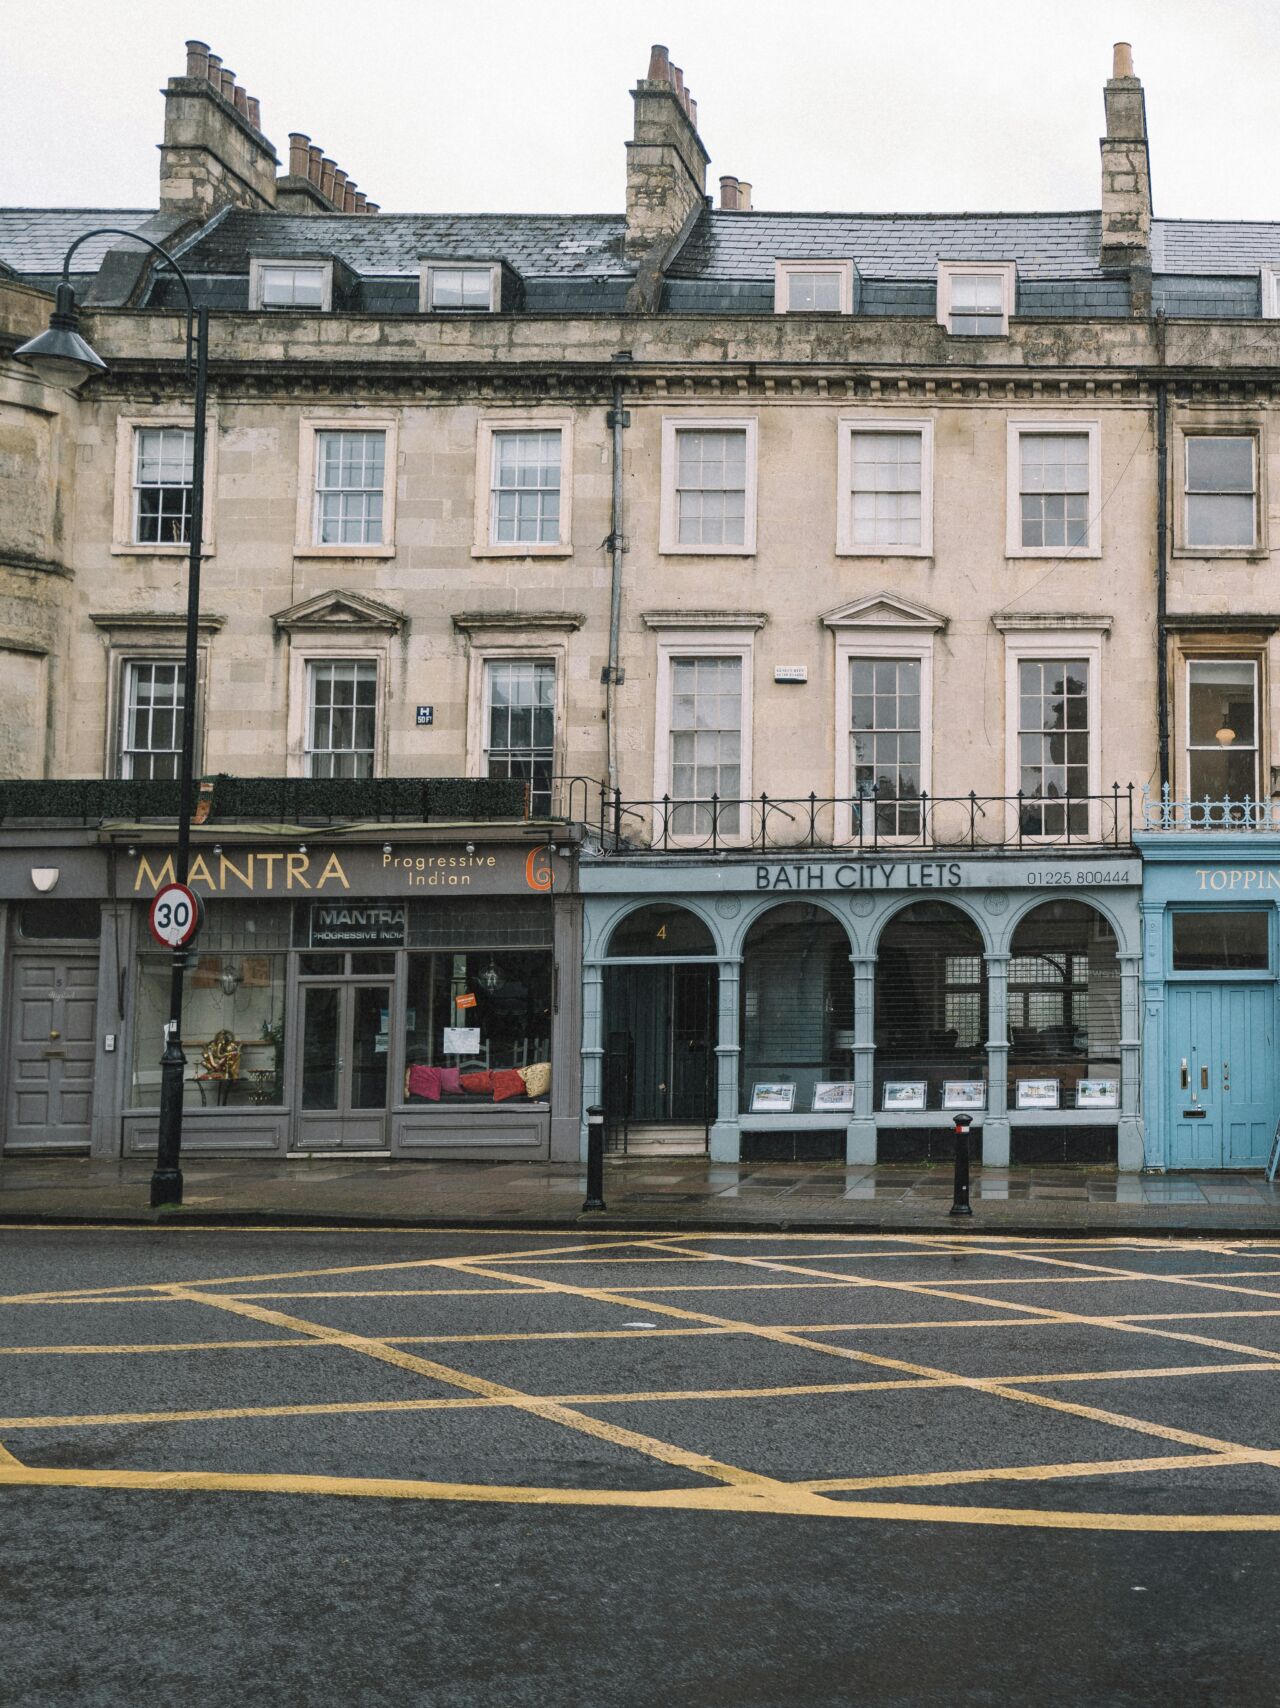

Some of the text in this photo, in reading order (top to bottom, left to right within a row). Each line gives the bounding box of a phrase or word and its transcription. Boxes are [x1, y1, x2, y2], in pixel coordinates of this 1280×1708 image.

[420, 707, 430, 716] H
[383, 853, 497, 870] Progressive
[134, 852, 350, 892] MANTRA
[408, 871, 471, 887] Indian
[756, 863, 962, 889] BATH CITY LETS
[1027, 871, 1130, 885] 01225 800444
[157, 902, 189, 929] 30
[319, 909, 404, 925] MANTRA
[656, 924, 667, 940] 4
